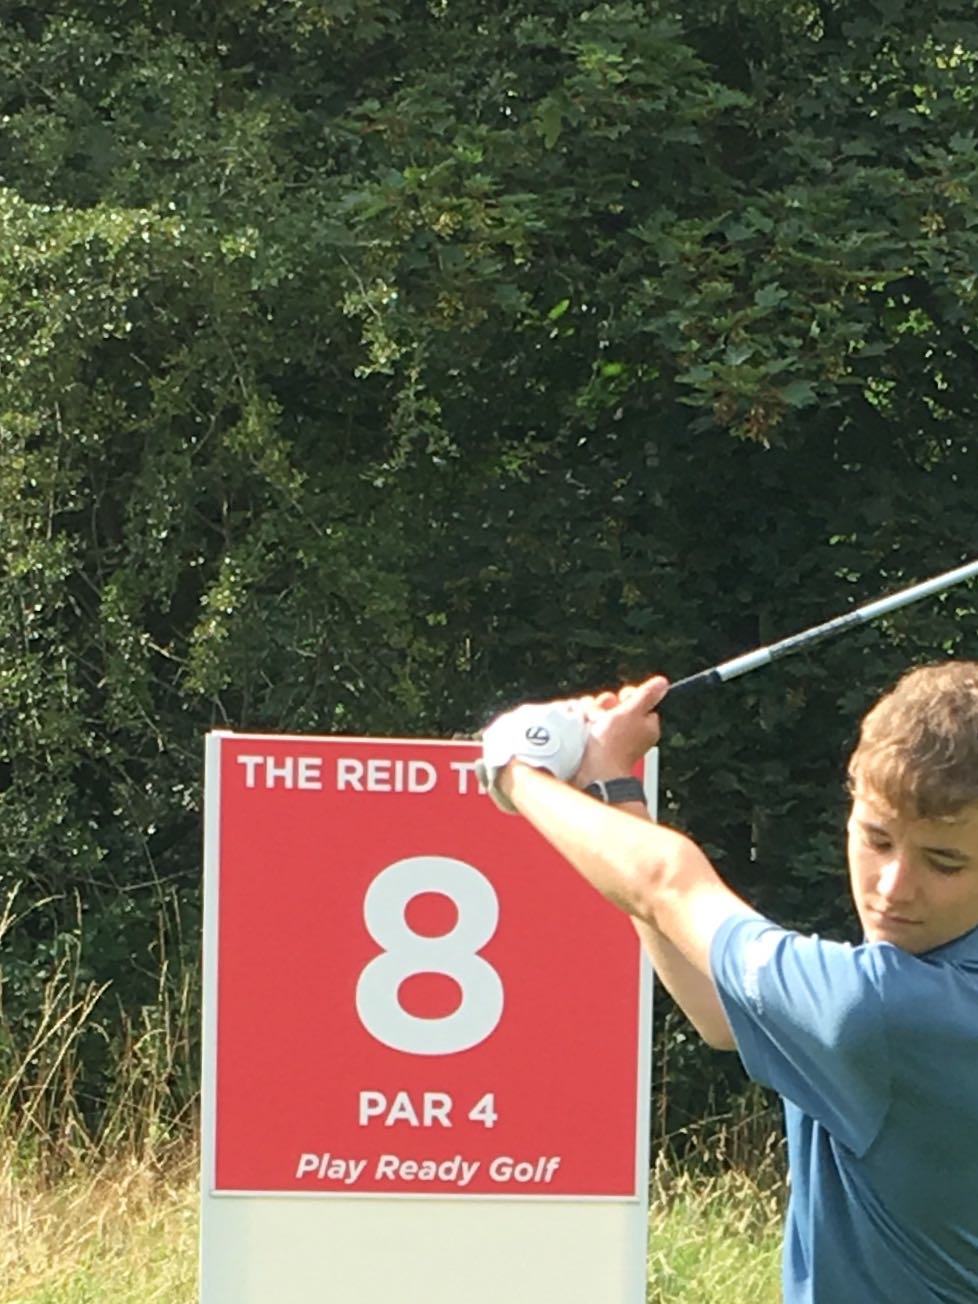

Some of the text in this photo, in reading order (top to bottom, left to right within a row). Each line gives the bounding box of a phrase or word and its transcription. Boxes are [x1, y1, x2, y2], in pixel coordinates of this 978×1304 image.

[237, 755, 487, 796] THE REID T
[355, 855, 505, 1056] 8
[359, 1091, 499, 1128] PAR 4
[295, 1153, 561, 1186] Play Ready Golf
